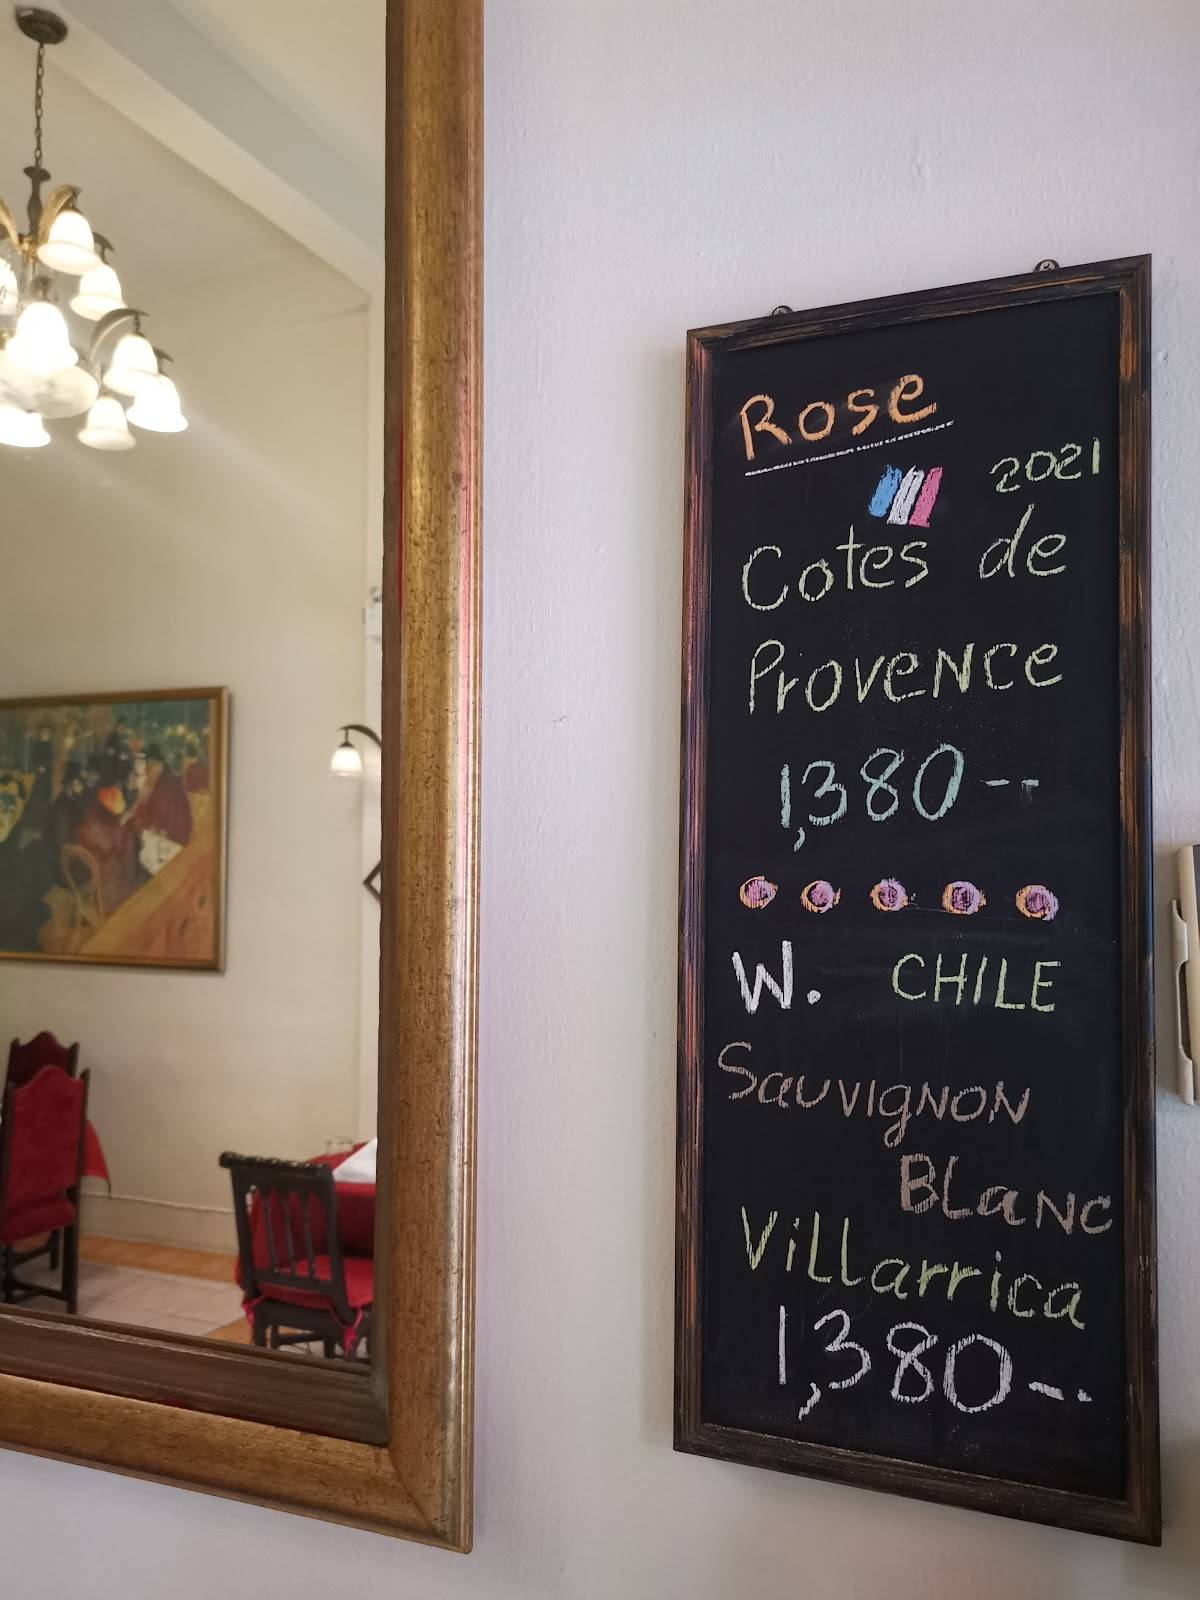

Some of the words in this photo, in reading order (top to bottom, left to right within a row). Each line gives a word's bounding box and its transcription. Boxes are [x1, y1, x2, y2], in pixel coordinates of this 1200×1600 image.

[739, 373, 938, 461] Rose
[988, 436, 1101, 493] 2021
[741, 523, 930, 612] Cotes
[978, 502, 1068, 580] de
[731, 939, 823, 1015] W.
[890, 952, 1063, 1013] CHILE
